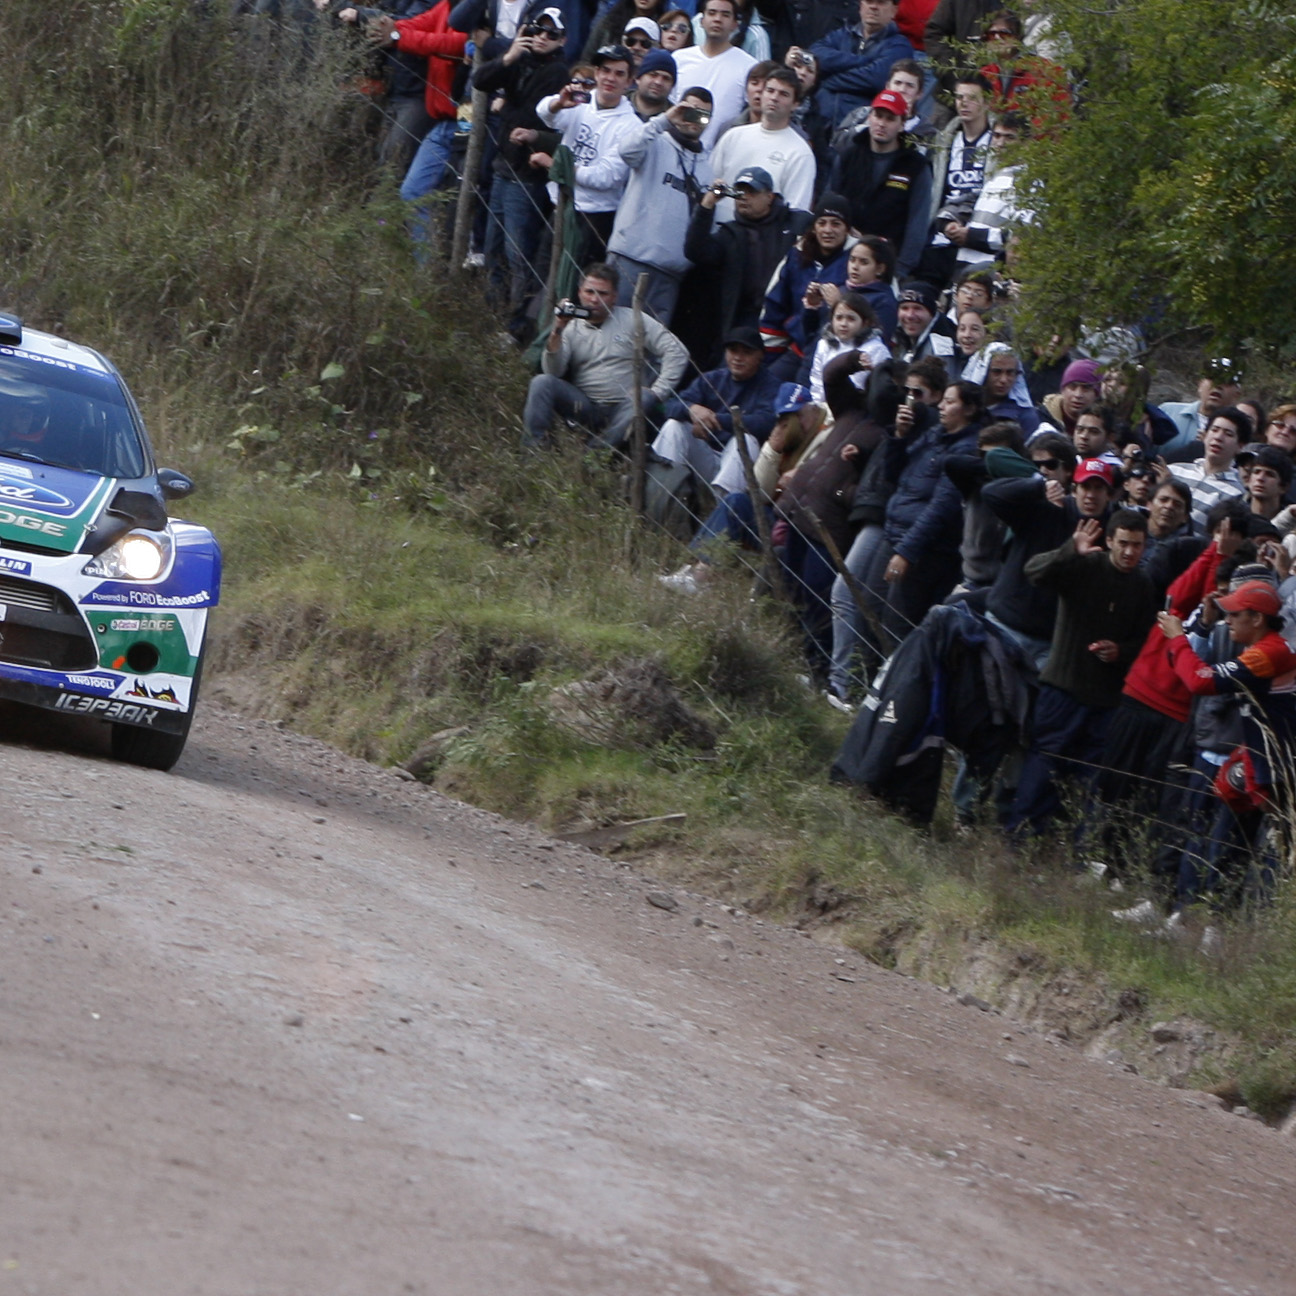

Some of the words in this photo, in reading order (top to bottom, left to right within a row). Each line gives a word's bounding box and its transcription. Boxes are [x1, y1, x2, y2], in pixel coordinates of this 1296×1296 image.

[92, 592, 120, 602] Powered
[130, 591, 156, 605] FORD
[156, 590, 210, 606] EcoBoost
[139, 619, 176, 631] EDGE
